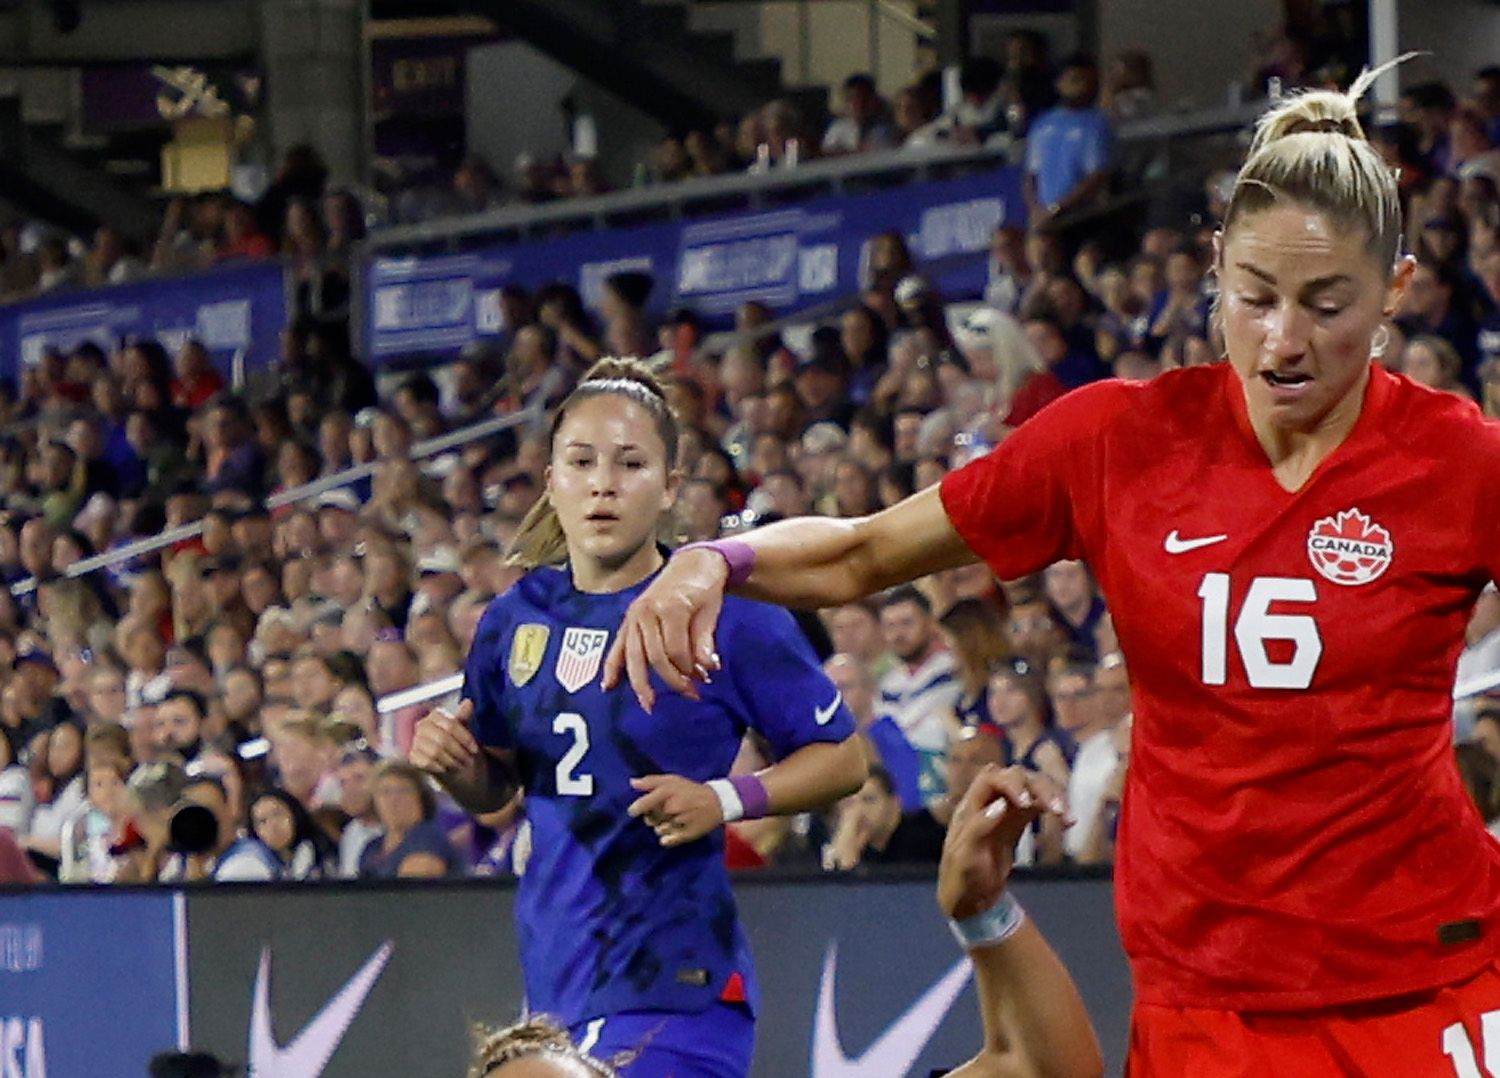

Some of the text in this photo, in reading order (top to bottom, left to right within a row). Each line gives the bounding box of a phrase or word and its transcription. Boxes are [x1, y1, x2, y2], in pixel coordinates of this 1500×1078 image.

[1312, 538, 1388, 557] CANADA
[566, 632, 604, 656] USA
[1198, 572, 1323, 689] 16
[552, 712, 594, 796] 2
